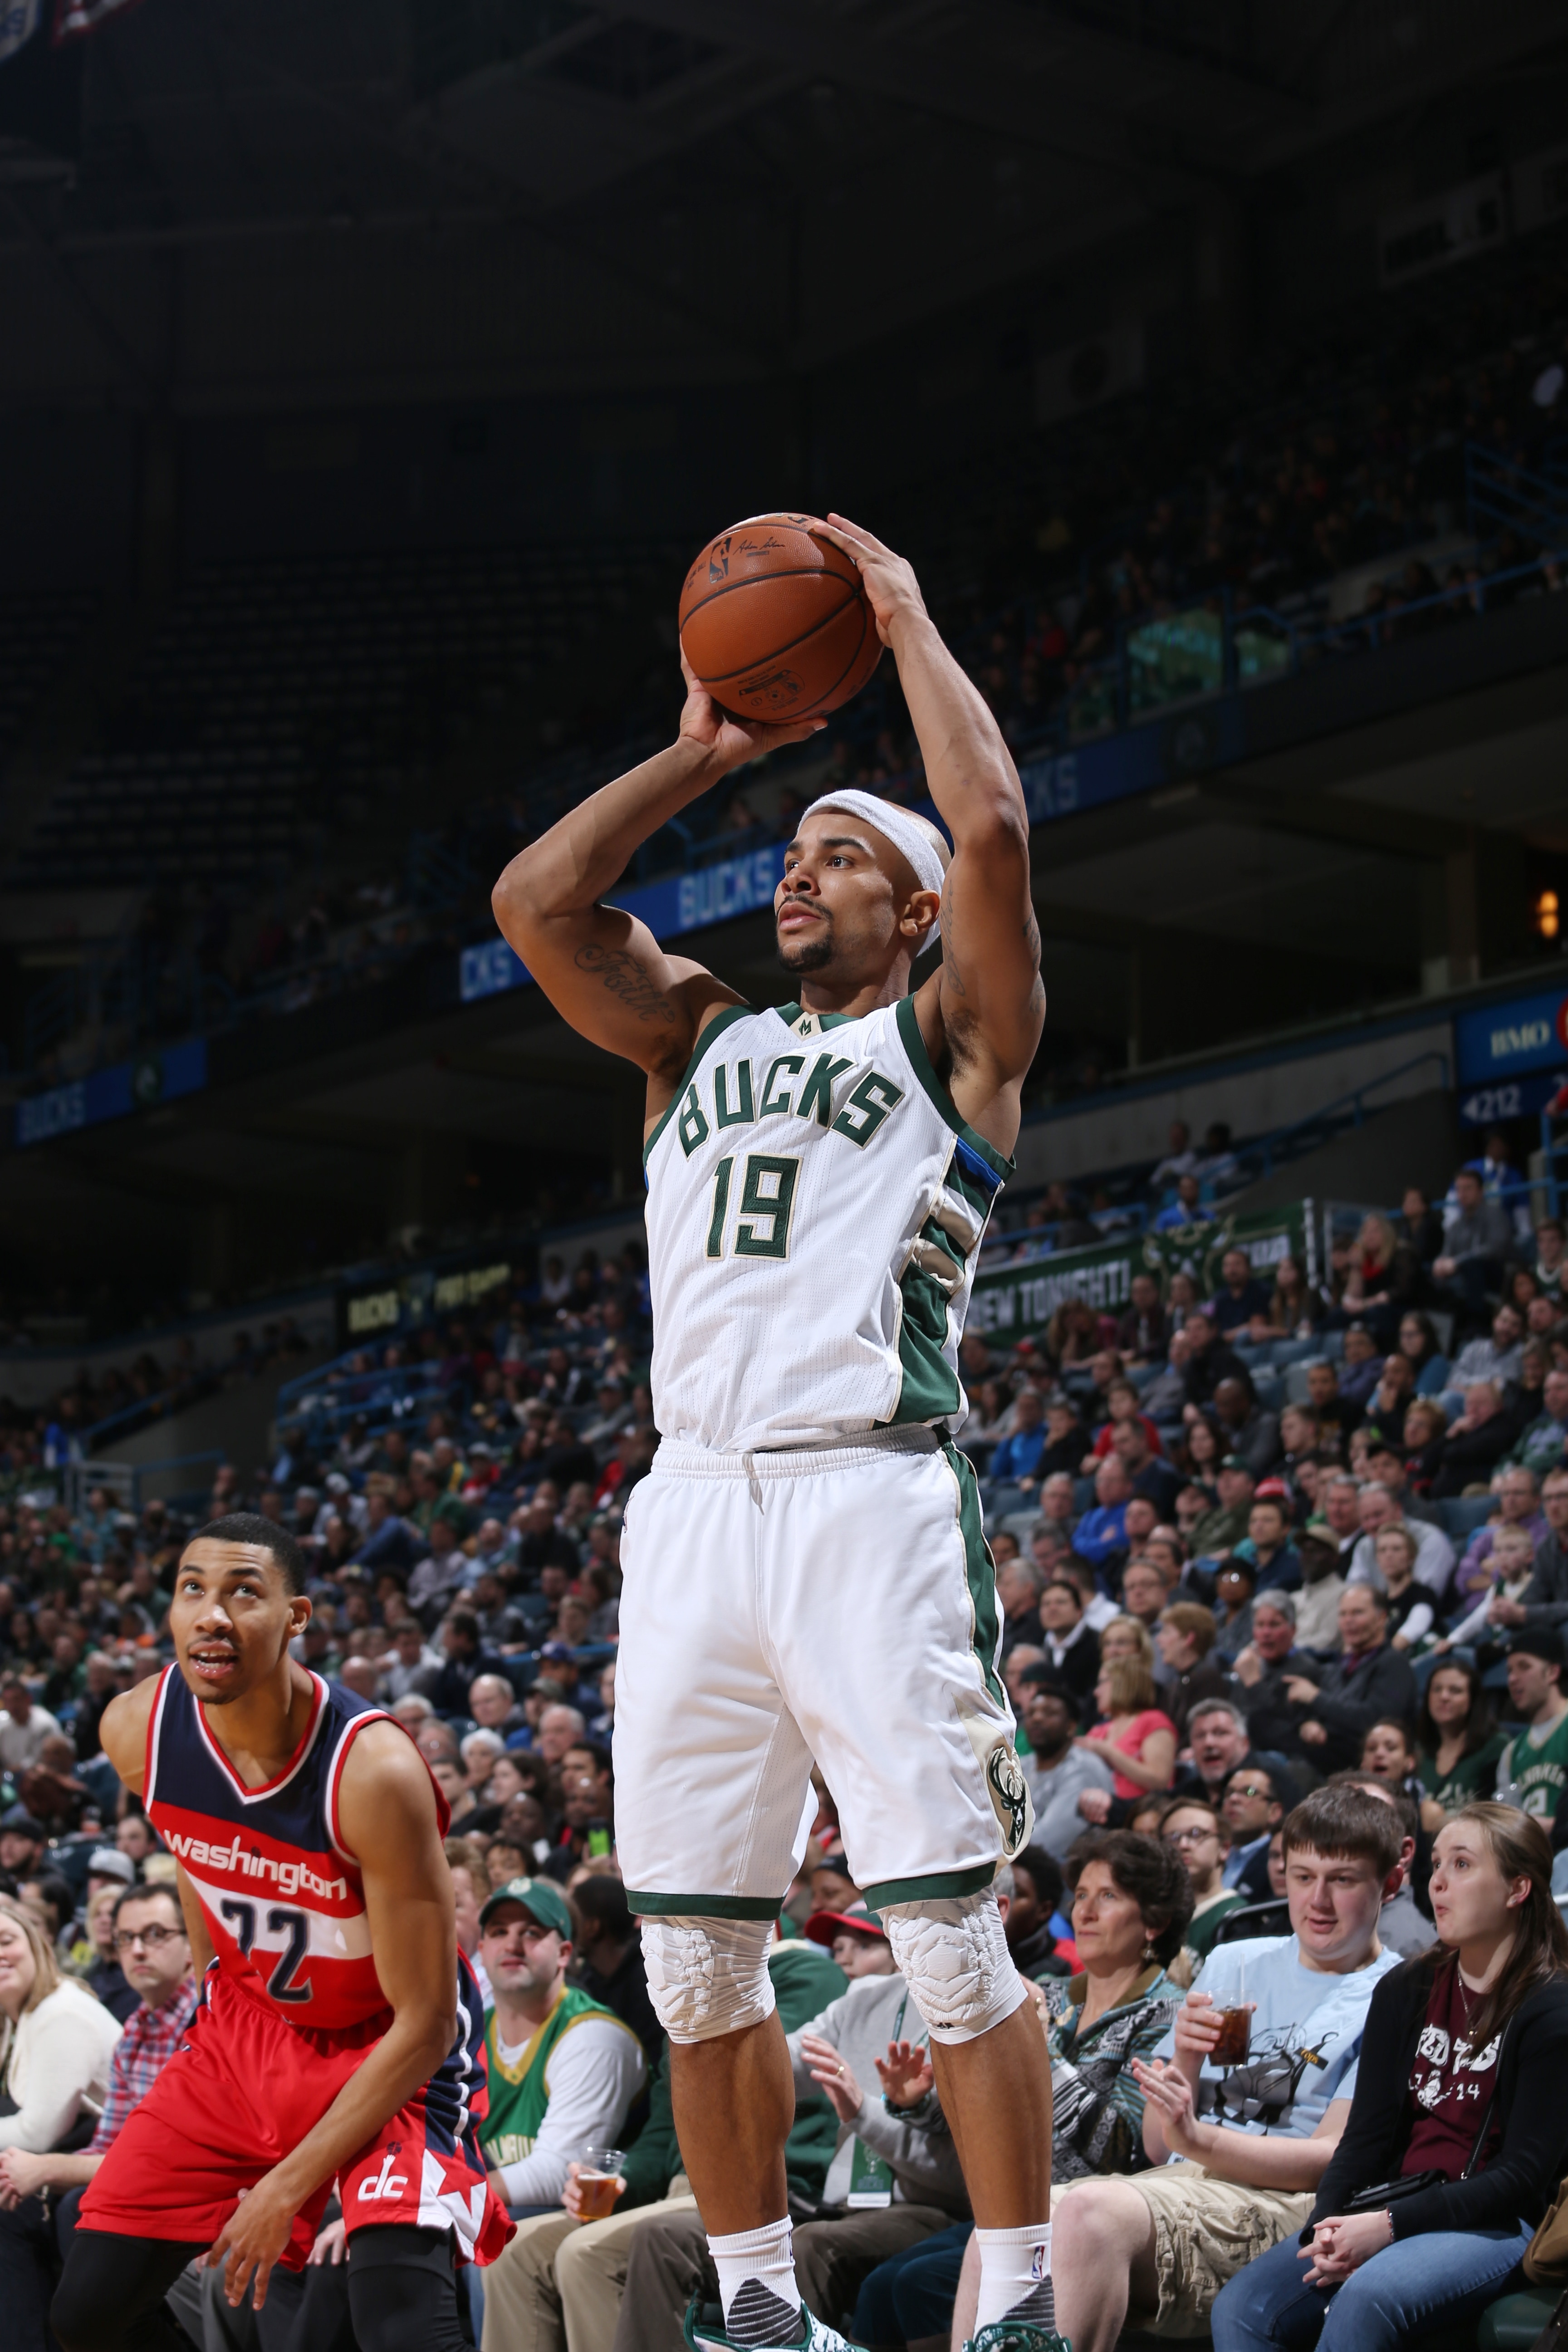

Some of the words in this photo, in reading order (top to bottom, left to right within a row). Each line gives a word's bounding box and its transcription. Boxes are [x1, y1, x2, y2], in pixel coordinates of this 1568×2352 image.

[711, 572, 723, 581] NBA
[679, 851, 773, 925] BUCKS
[677, 1052, 905, 1162] BUCKS
[705, 1152, 803, 1263] 19
[164, 1829, 347, 1901] washington
[358, 2154, 408, 2200] dc
